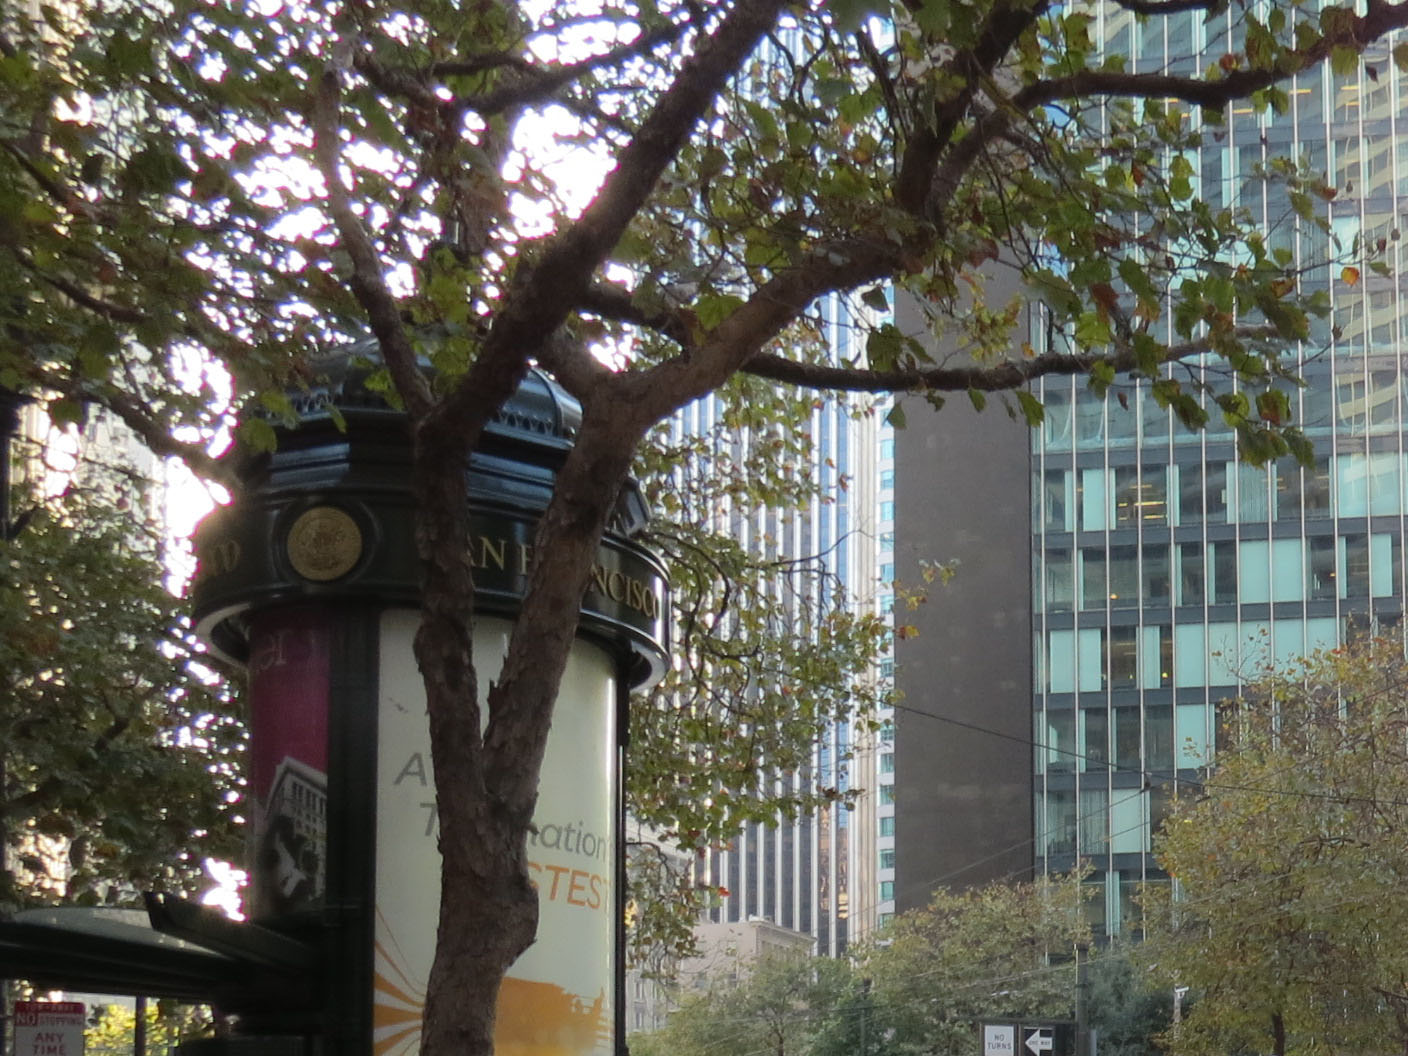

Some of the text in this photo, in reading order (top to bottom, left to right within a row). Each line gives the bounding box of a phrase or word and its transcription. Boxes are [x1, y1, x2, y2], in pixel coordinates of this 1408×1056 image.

[35, 1033, 64, 1042] ANY
[994, 1034, 1004, 1042] NO
[987, 1042, 1012, 1050] TURNS
[33, 1045, 66, 1056] TIME
